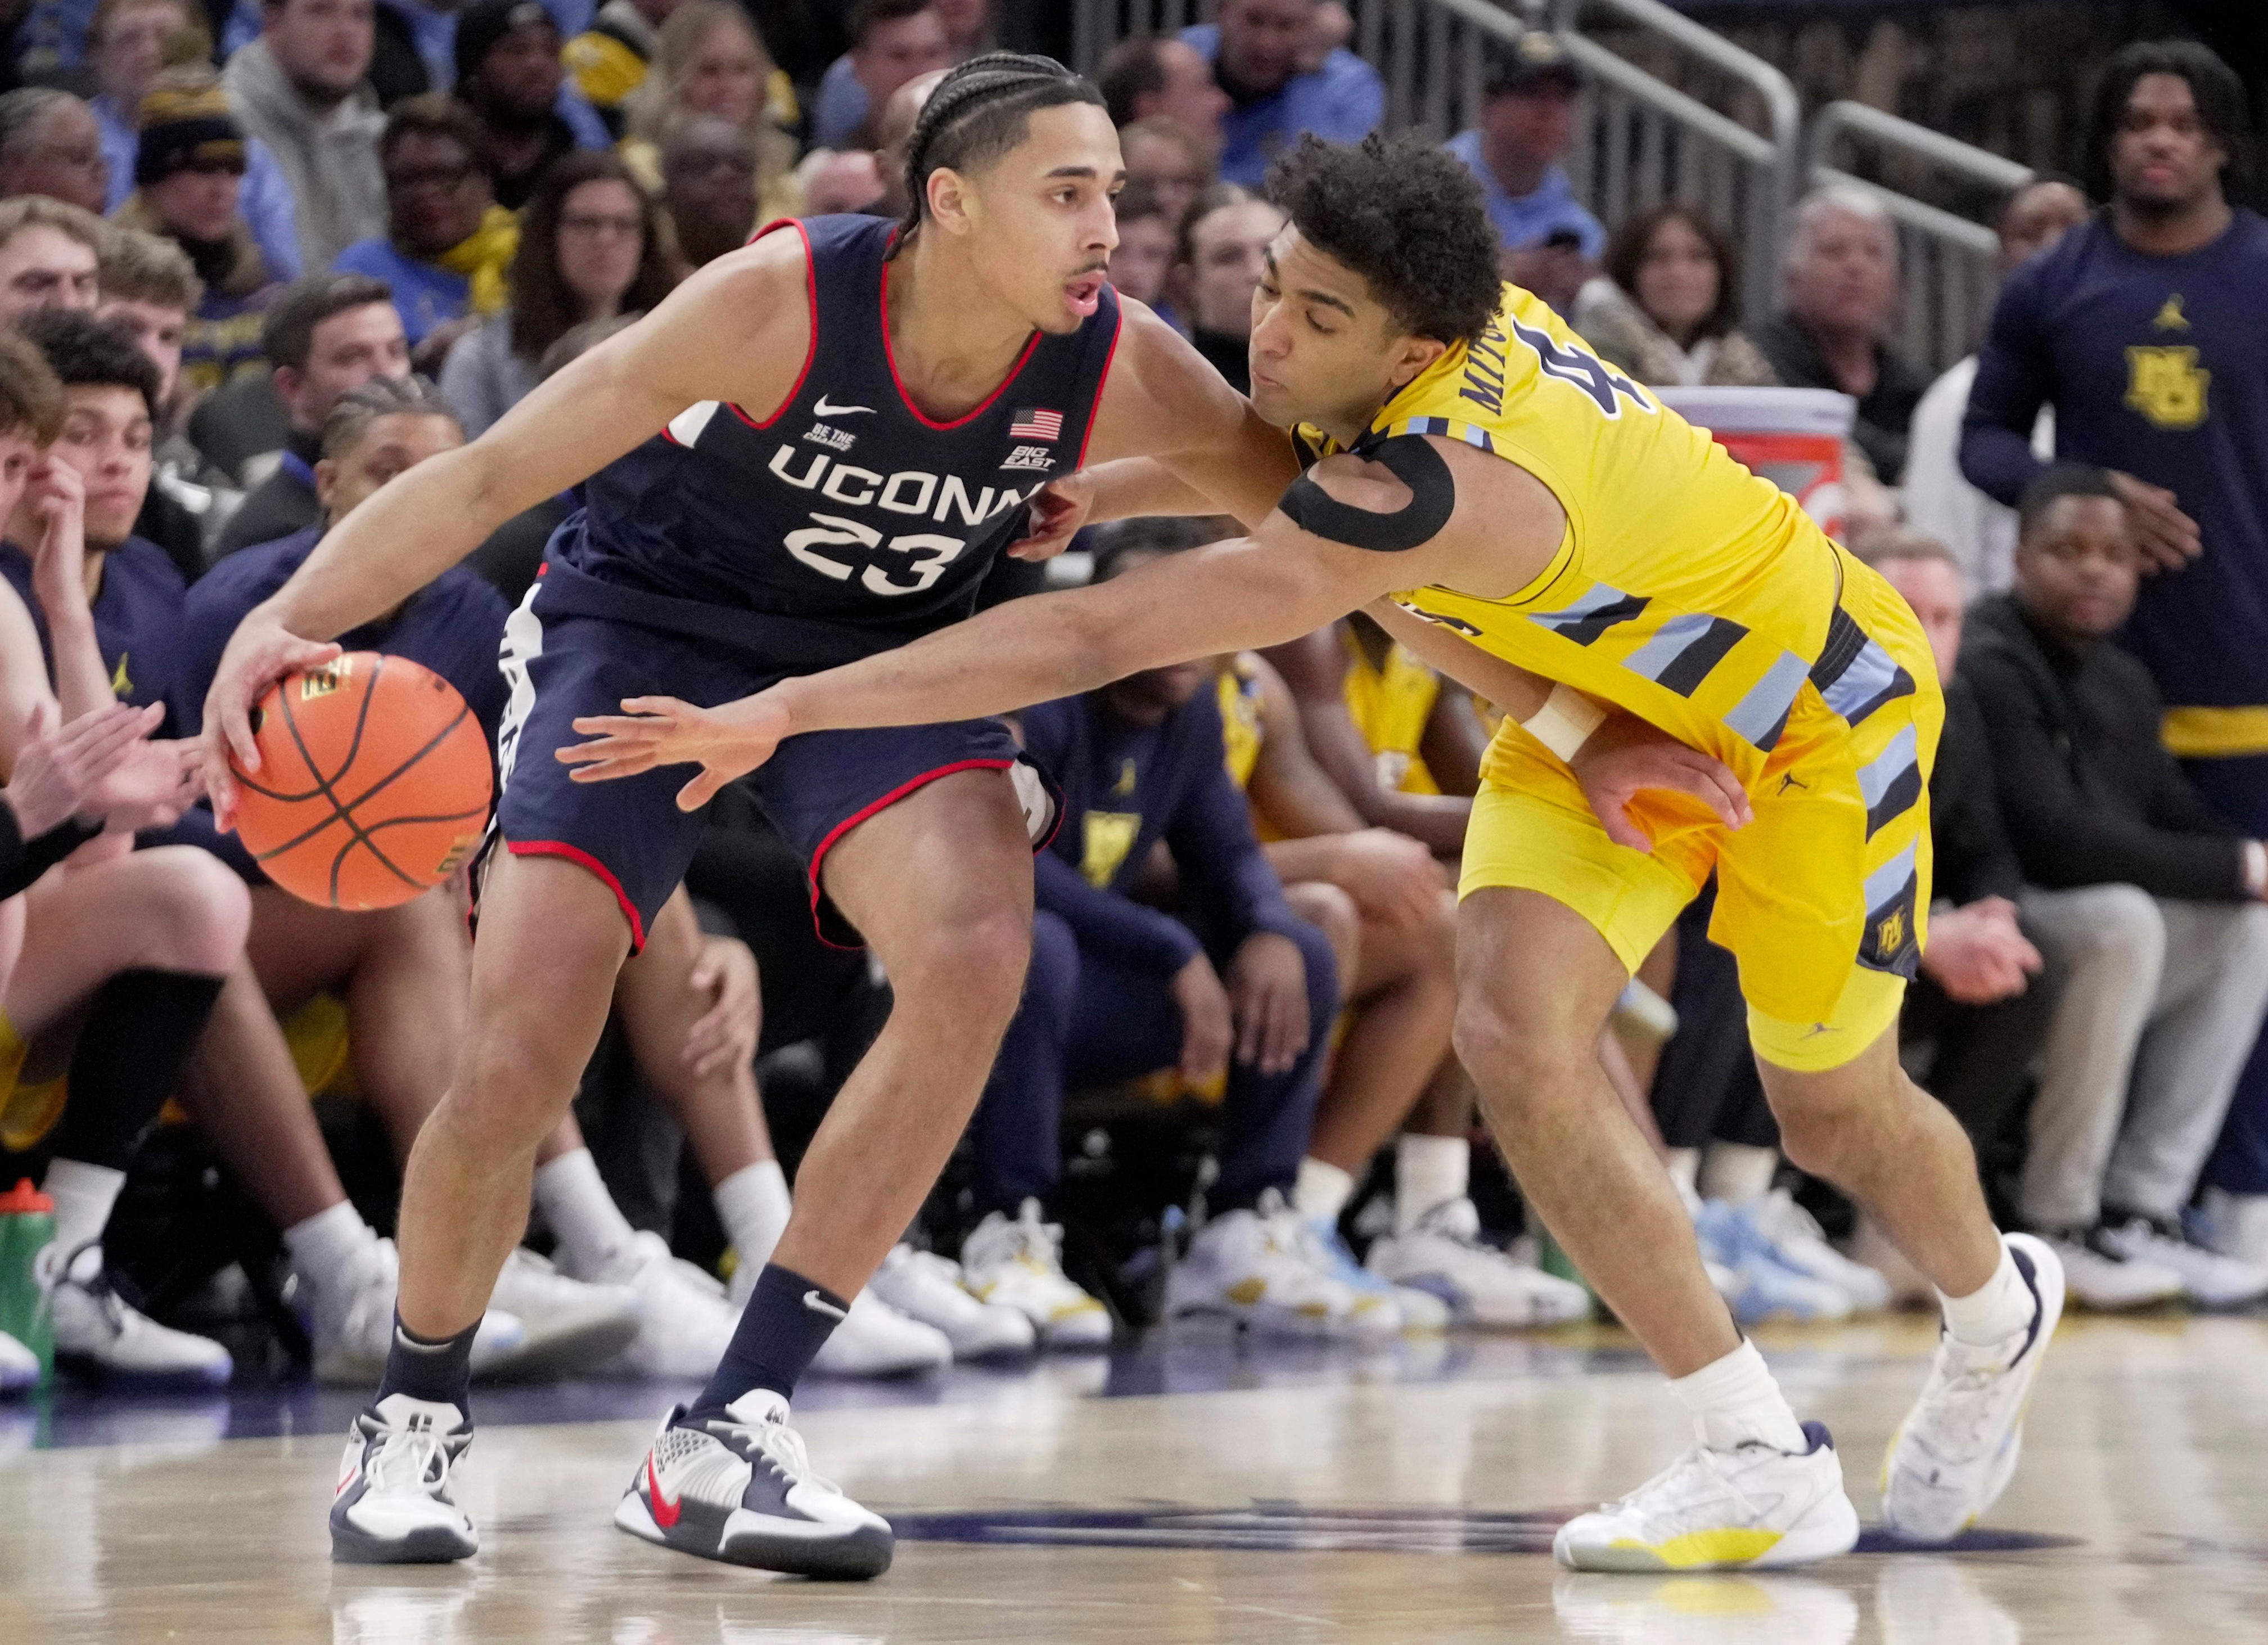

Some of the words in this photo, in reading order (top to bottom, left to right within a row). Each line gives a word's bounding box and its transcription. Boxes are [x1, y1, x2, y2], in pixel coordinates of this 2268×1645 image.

[1511, 313, 1657, 420] 4
[811, 422, 832, 437] BE
[832, 428, 857, 445] THE
[1004, 454, 1057, 468] EAST
[1011, 445, 1049, 458] BIG
[783, 512, 966, 596] 23
